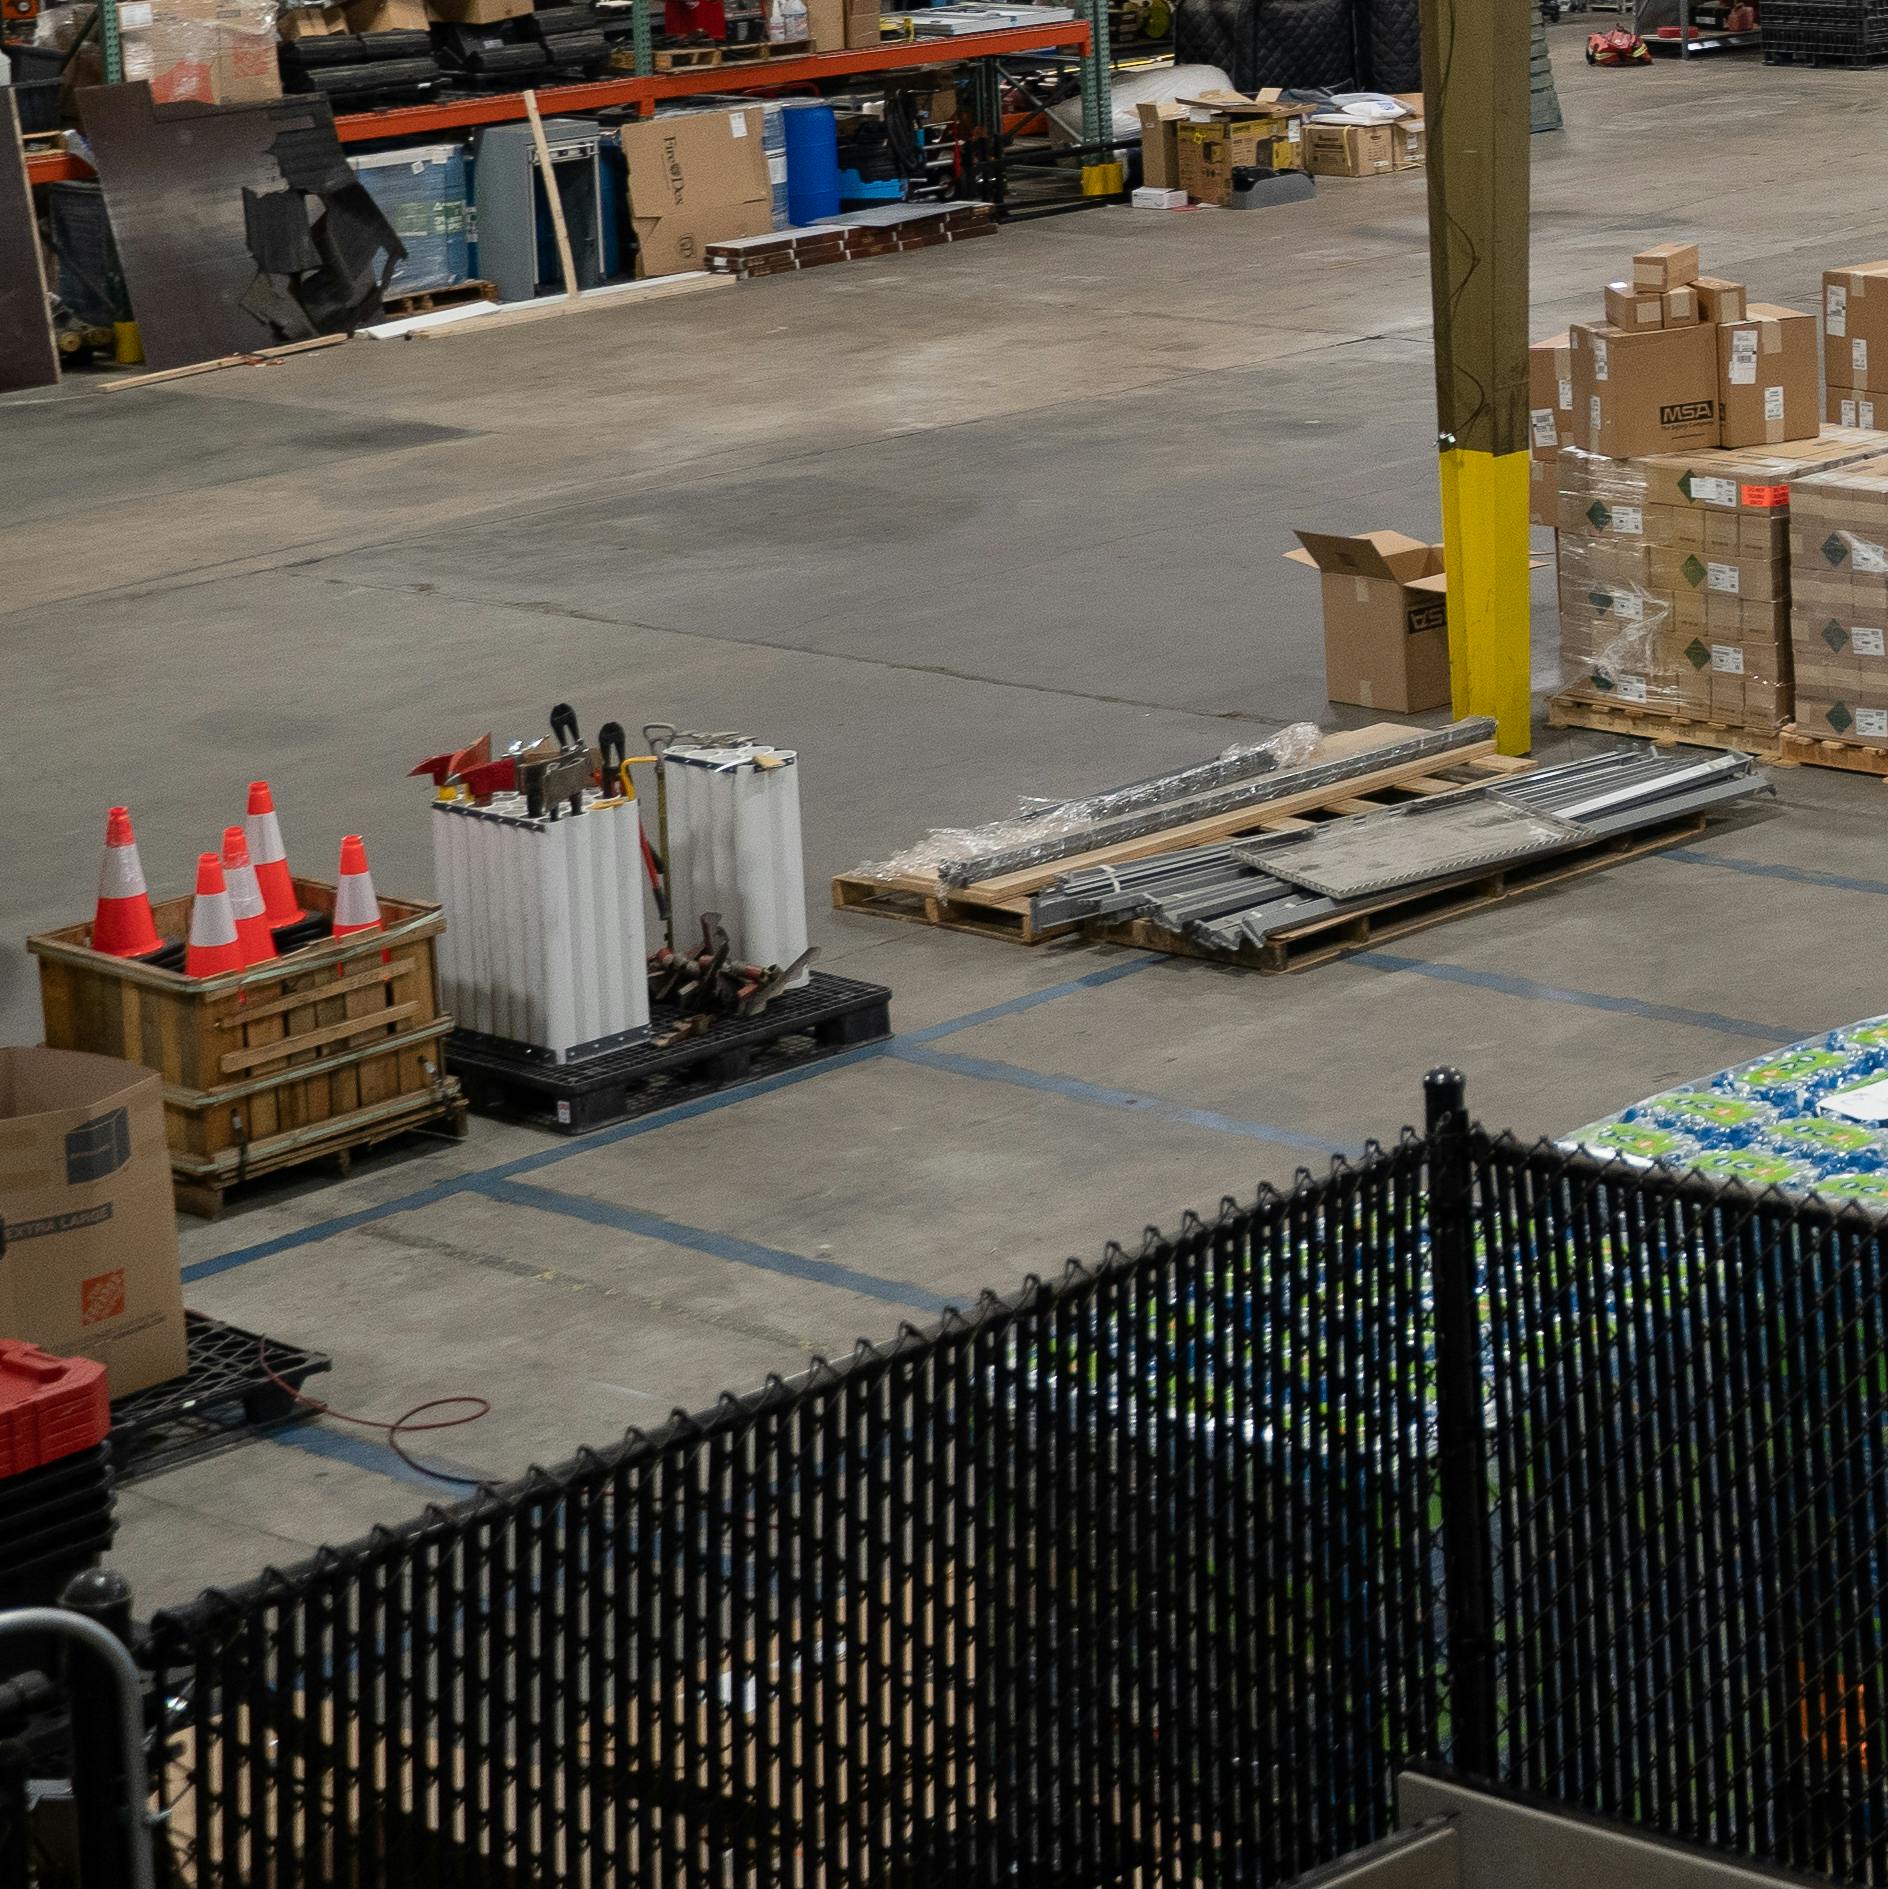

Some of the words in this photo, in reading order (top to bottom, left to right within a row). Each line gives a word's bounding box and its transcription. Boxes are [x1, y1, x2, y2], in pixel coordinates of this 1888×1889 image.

[1662, 403, 1712, 423] MSA
[1411, 605, 1447, 631] SA
[65, 1206, 110, 1227] LARGE
